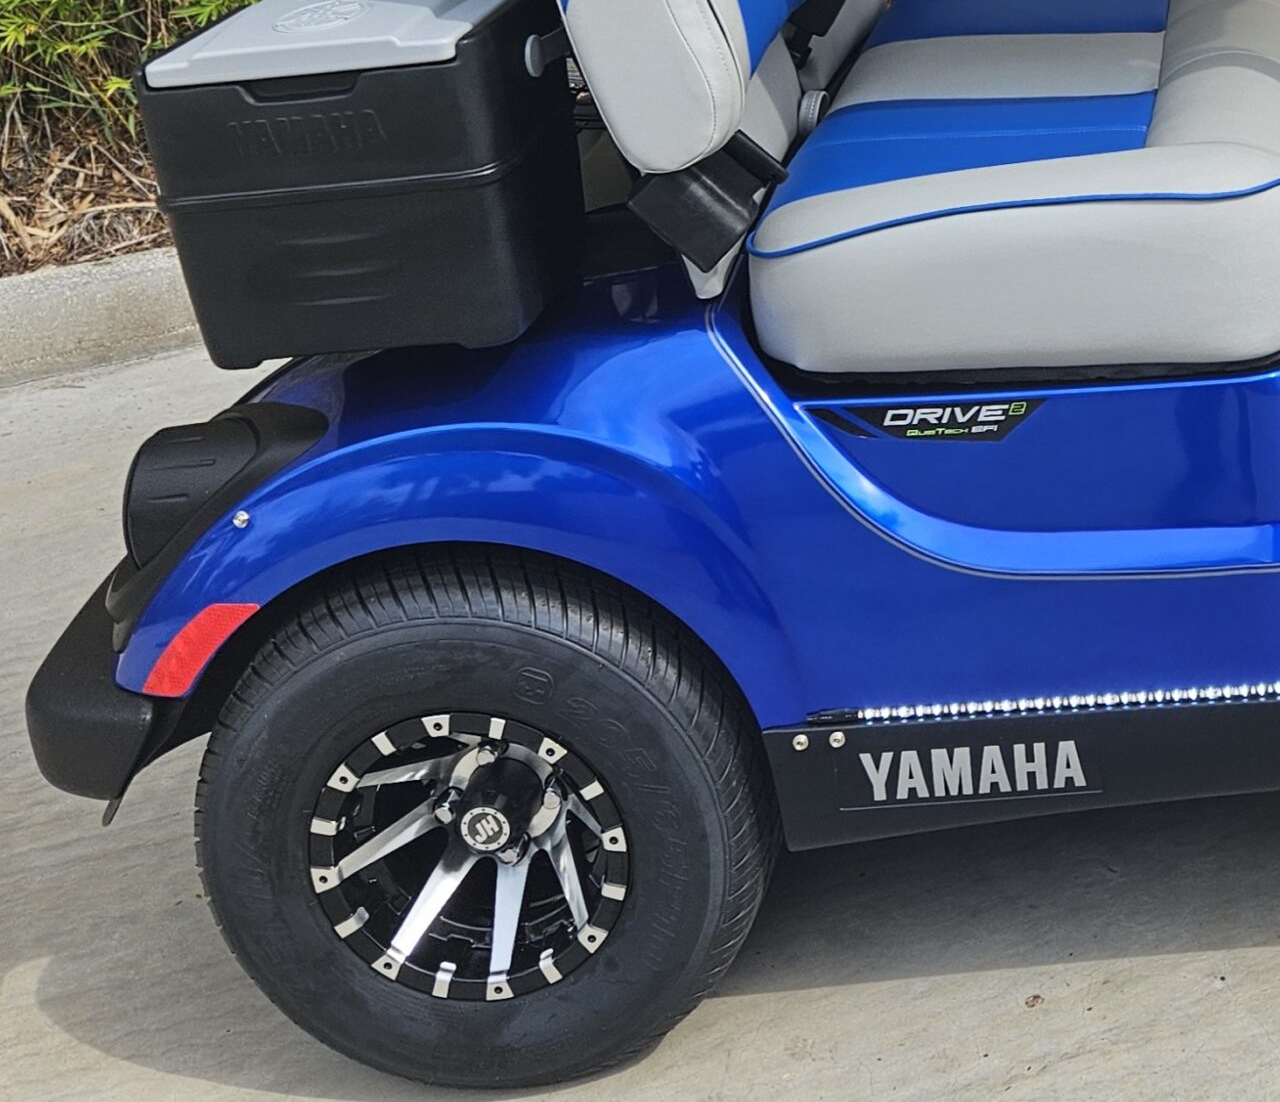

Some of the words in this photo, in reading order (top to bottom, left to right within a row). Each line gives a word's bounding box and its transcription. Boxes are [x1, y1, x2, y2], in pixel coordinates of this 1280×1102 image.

[971, 424, 998, 433] EFI
[858, 740, 1087, 801] YAMAHA
[474, 814, 500, 844] JH
